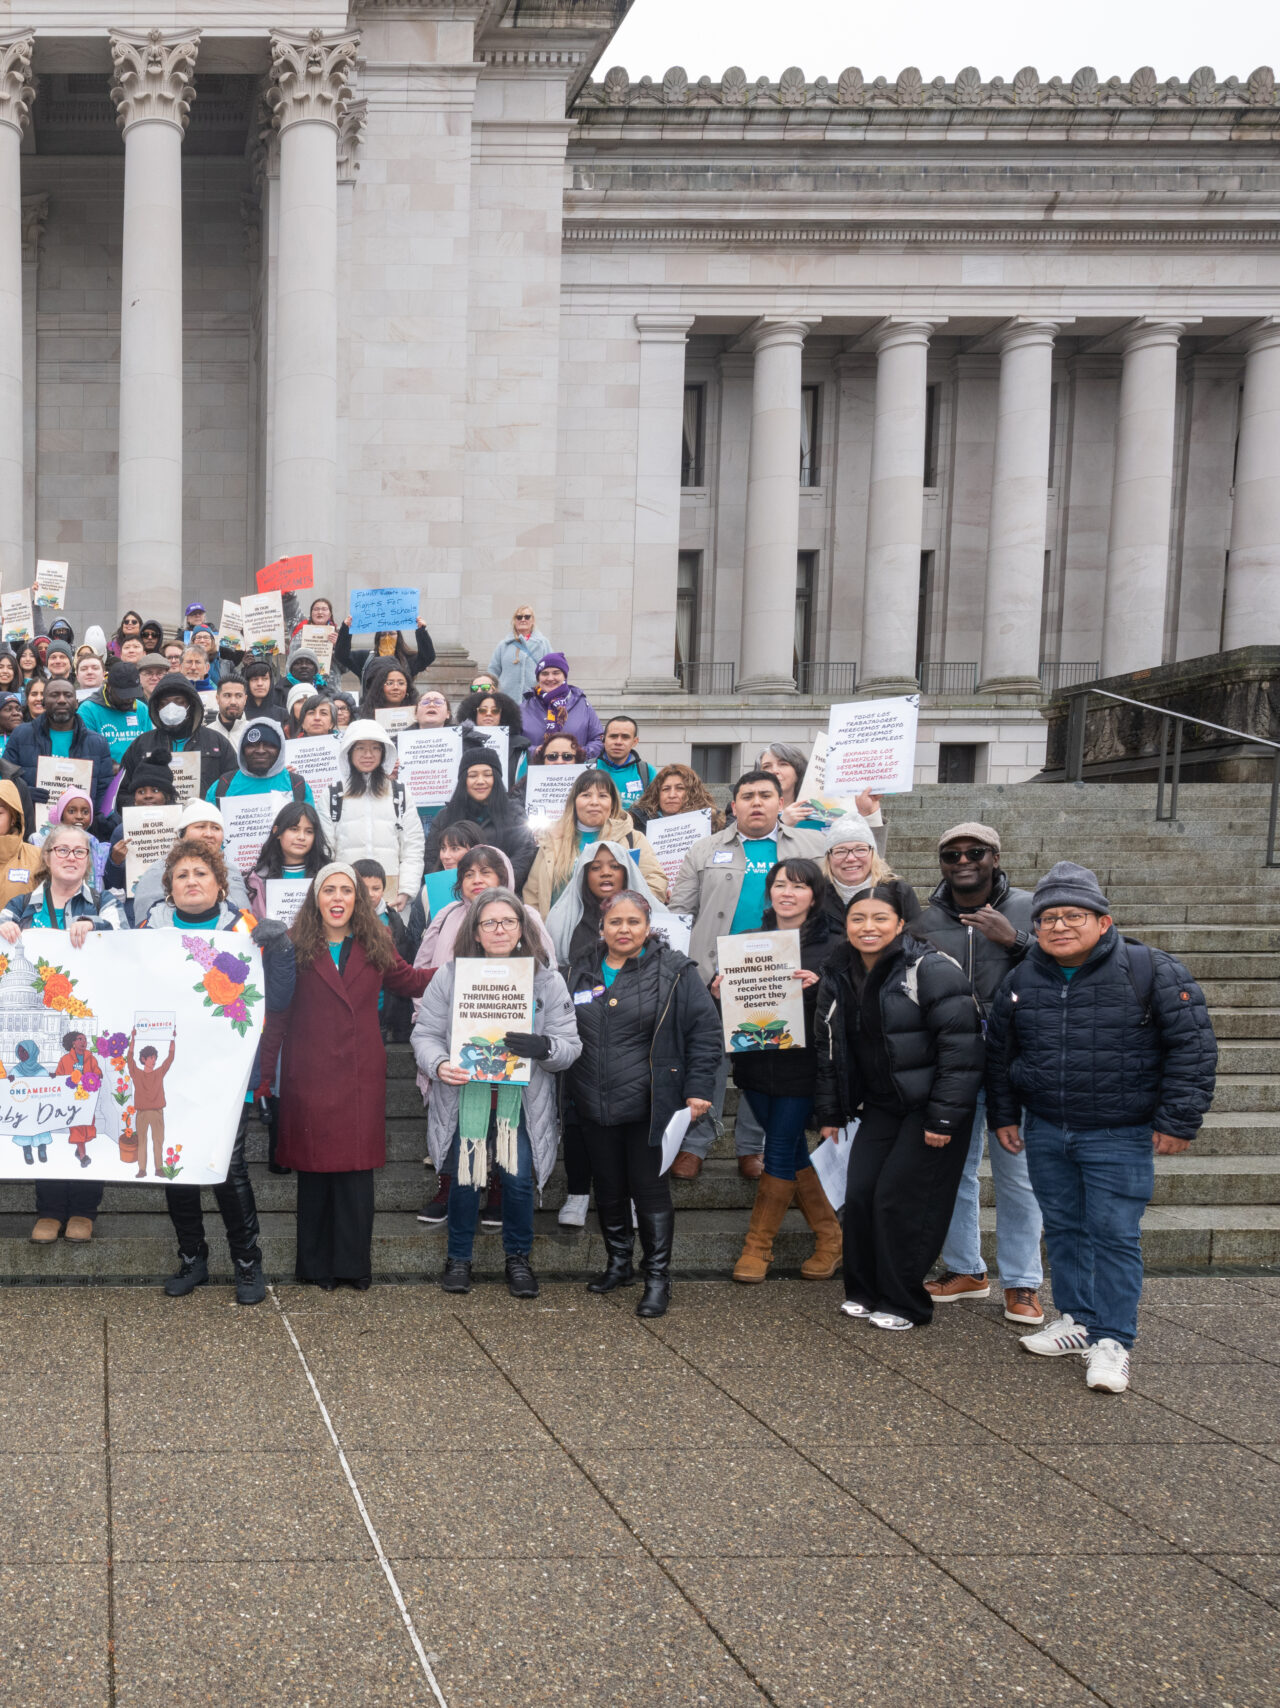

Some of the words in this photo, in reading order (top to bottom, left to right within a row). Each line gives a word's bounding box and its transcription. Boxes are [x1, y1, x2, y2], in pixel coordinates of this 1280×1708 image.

[846, 716, 898, 726] TRABAJADORES
[838, 725, 880, 733] MERECEMOS
[843, 755, 883, 763] BENEFICIOS
[842, 768, 894, 776] TRABAJADORES
[724, 965, 762, 975] THRIVING
[729, 977, 757, 986] asylum
[758, 975, 791, 983] seekers
[738, 984, 767, 993] receive
[735, 992, 766, 1001] support
[768, 991, 787, 999] they
[10, 1086, 61, 1095] ONEAMERICA
[36, 1102, 82, 1125] Day
